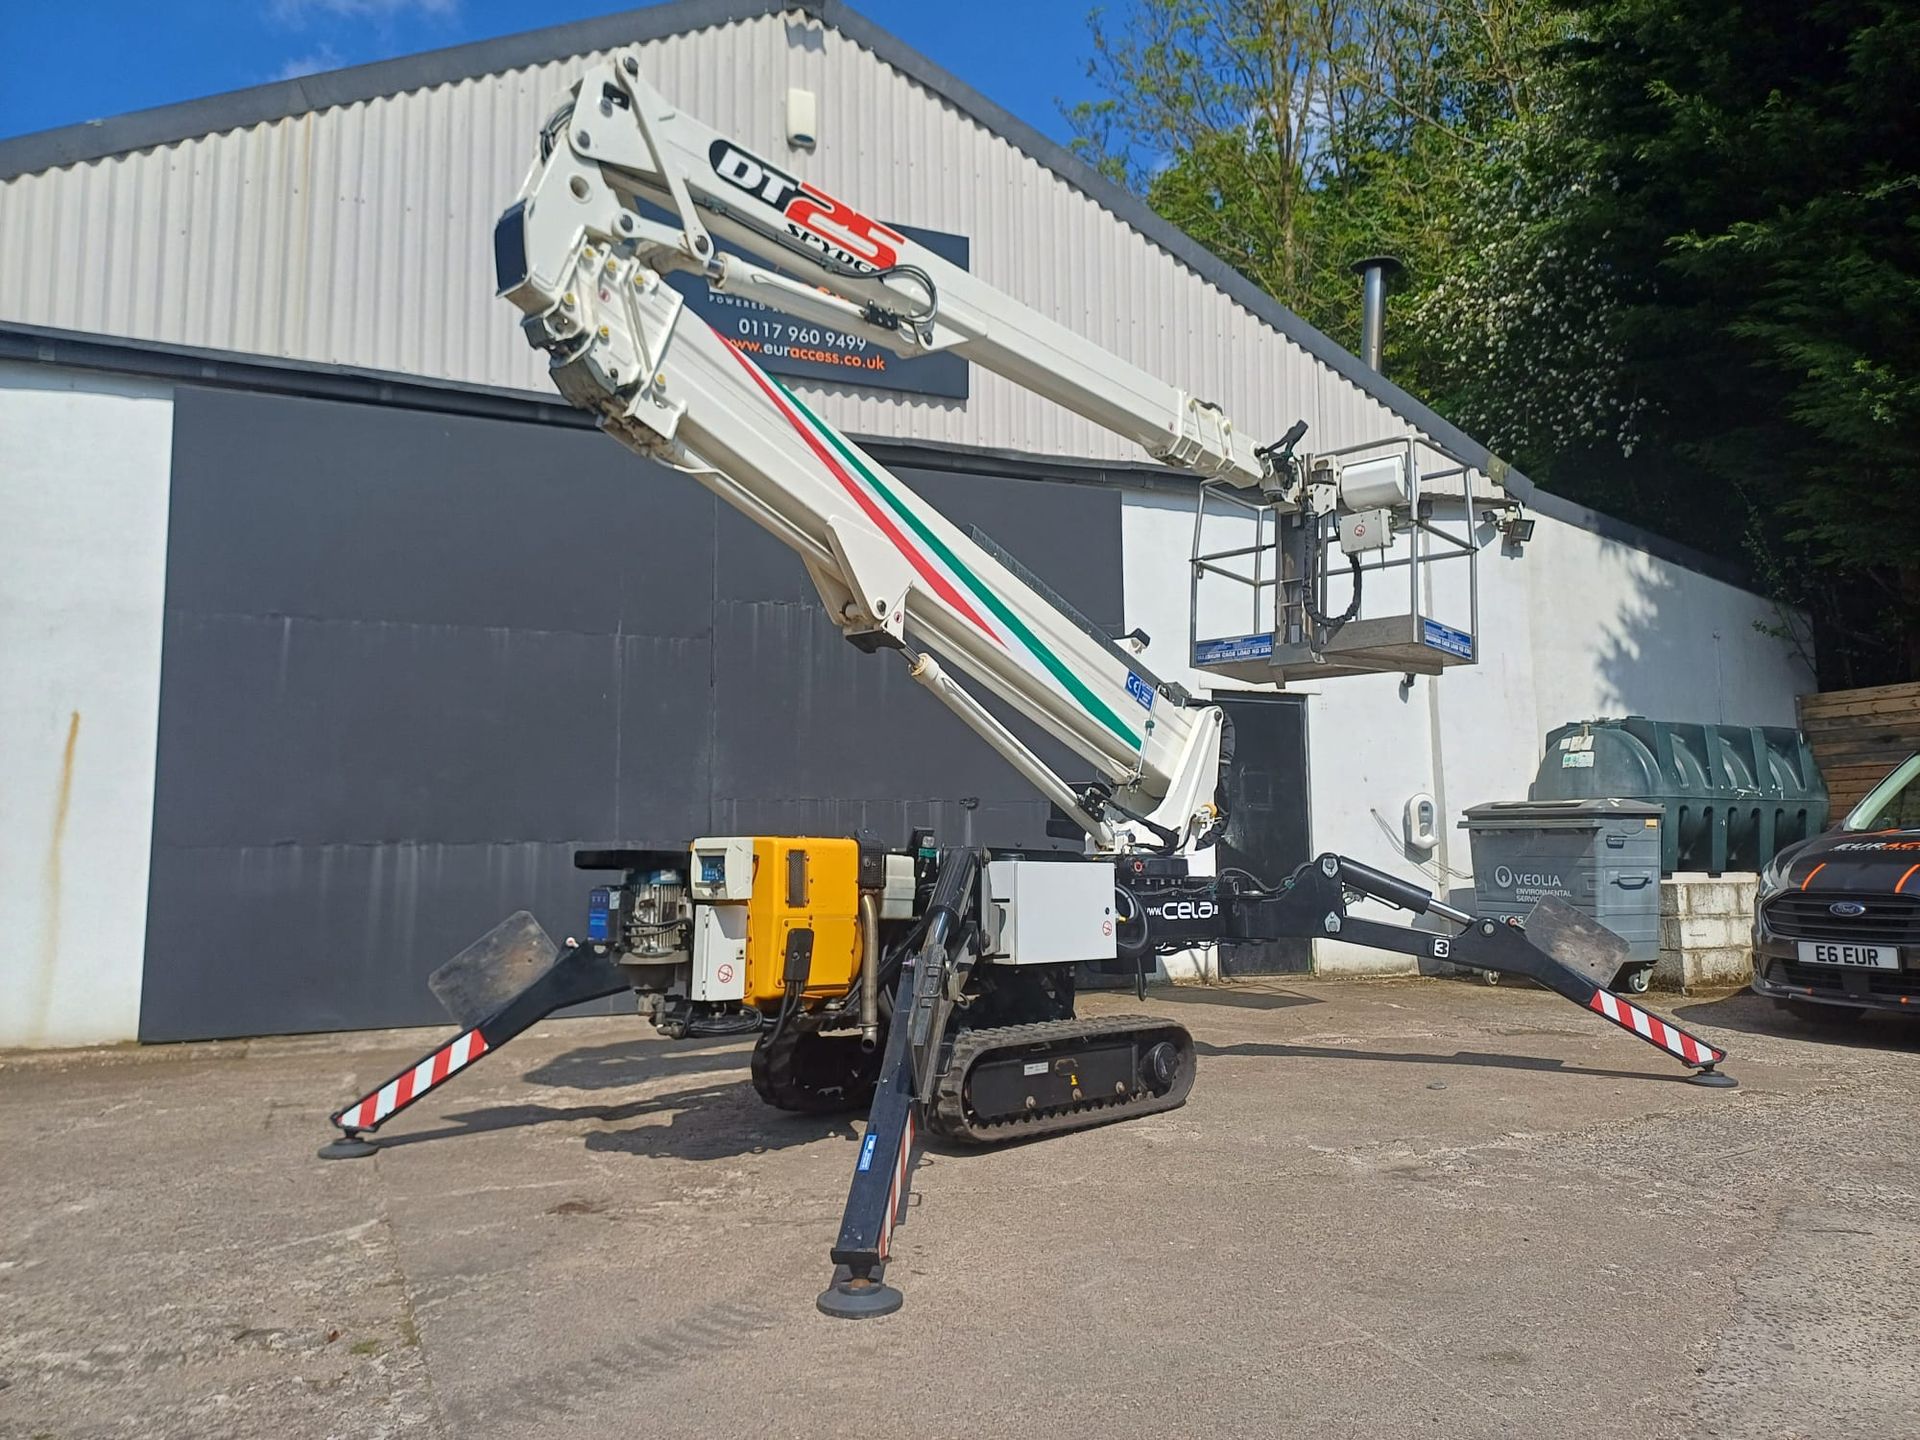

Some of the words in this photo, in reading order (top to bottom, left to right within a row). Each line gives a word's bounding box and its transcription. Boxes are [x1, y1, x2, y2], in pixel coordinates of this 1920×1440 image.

[784, 223, 878, 273] SPYDE
[709, 294, 766, 311] POWERED
[739, 318, 782, 339] 0117
[788, 326, 820, 345] 960
[825, 331, 867, 352] 9499
[730, 338, 886, 371] ww.euraccess.co.uk
[1514, 874, 1562, 887] VEOLIA
[1516, 888, 1572, 897] ENVIRONMENTAL
[1516, 895, 1540, 903] SERVIC
[1436, 941, 1448, 955] 3
[1816, 945, 1838, 963] E6
[1843, 947, 1879, 966] EUR
